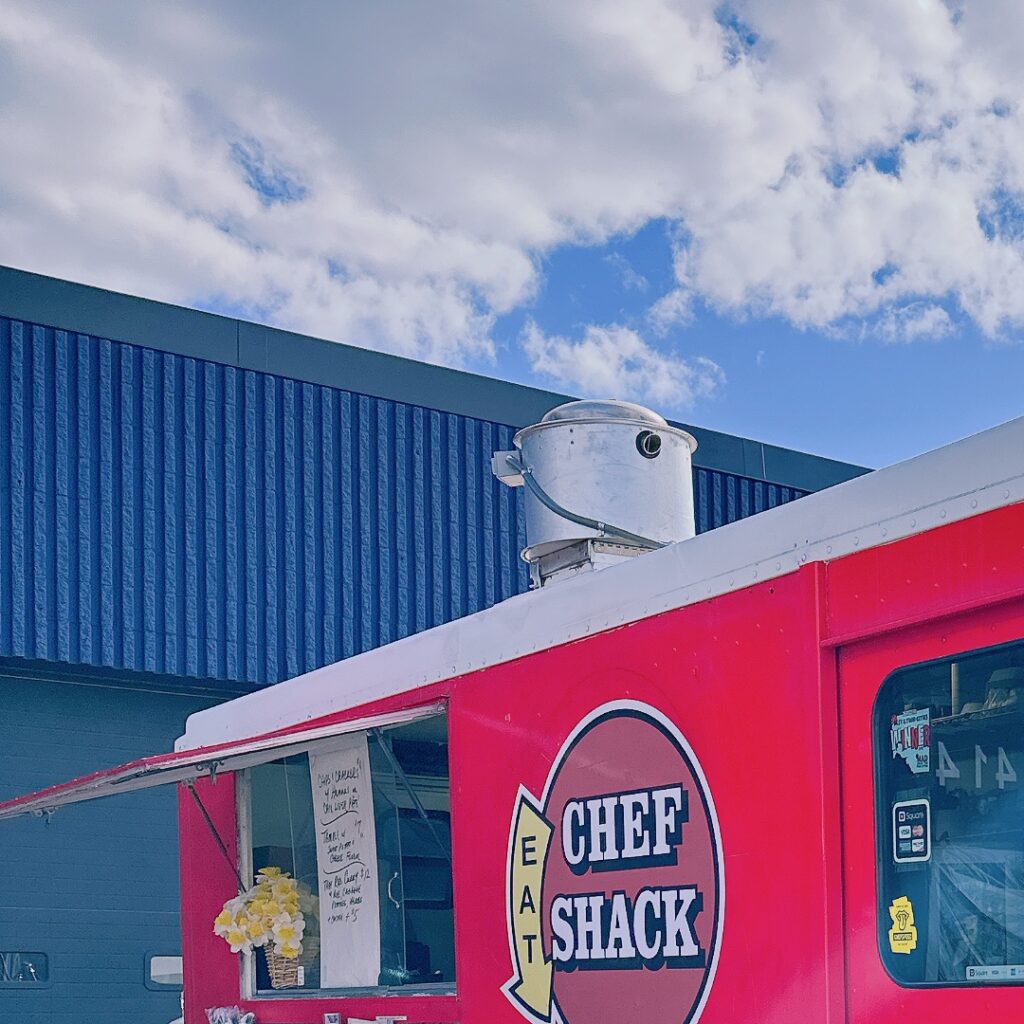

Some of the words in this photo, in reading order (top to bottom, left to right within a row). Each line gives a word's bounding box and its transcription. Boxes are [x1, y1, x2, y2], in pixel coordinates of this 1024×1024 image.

[890, 724, 932, 751] WINNER
[561, 785, 685, 870] CHEF
[519, 834, 537, 964] EAT
[550, 887, 702, 966] SHACK
